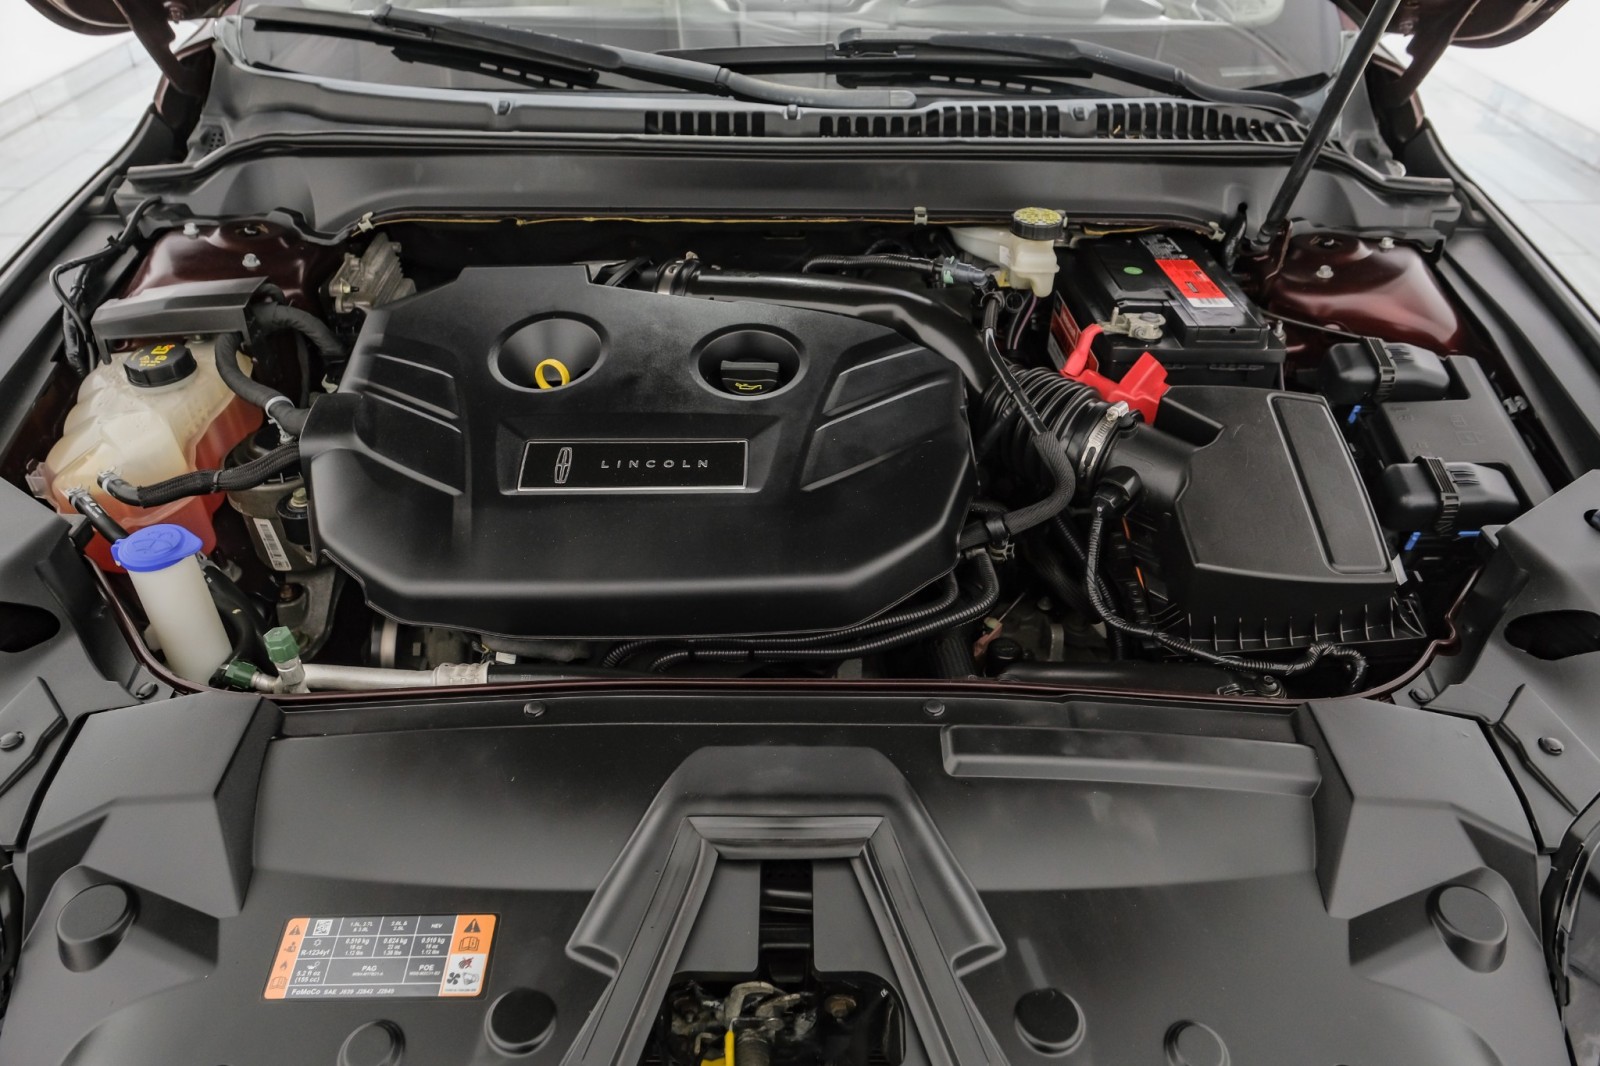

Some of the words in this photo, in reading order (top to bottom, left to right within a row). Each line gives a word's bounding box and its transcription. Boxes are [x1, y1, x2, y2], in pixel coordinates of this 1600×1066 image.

[600, 460, 709, 469] LINCOLN
[361, 938, 370, 946] kg
[437, 937, 446, 945] kg
[291, 988, 321, 996] FoMoCo
